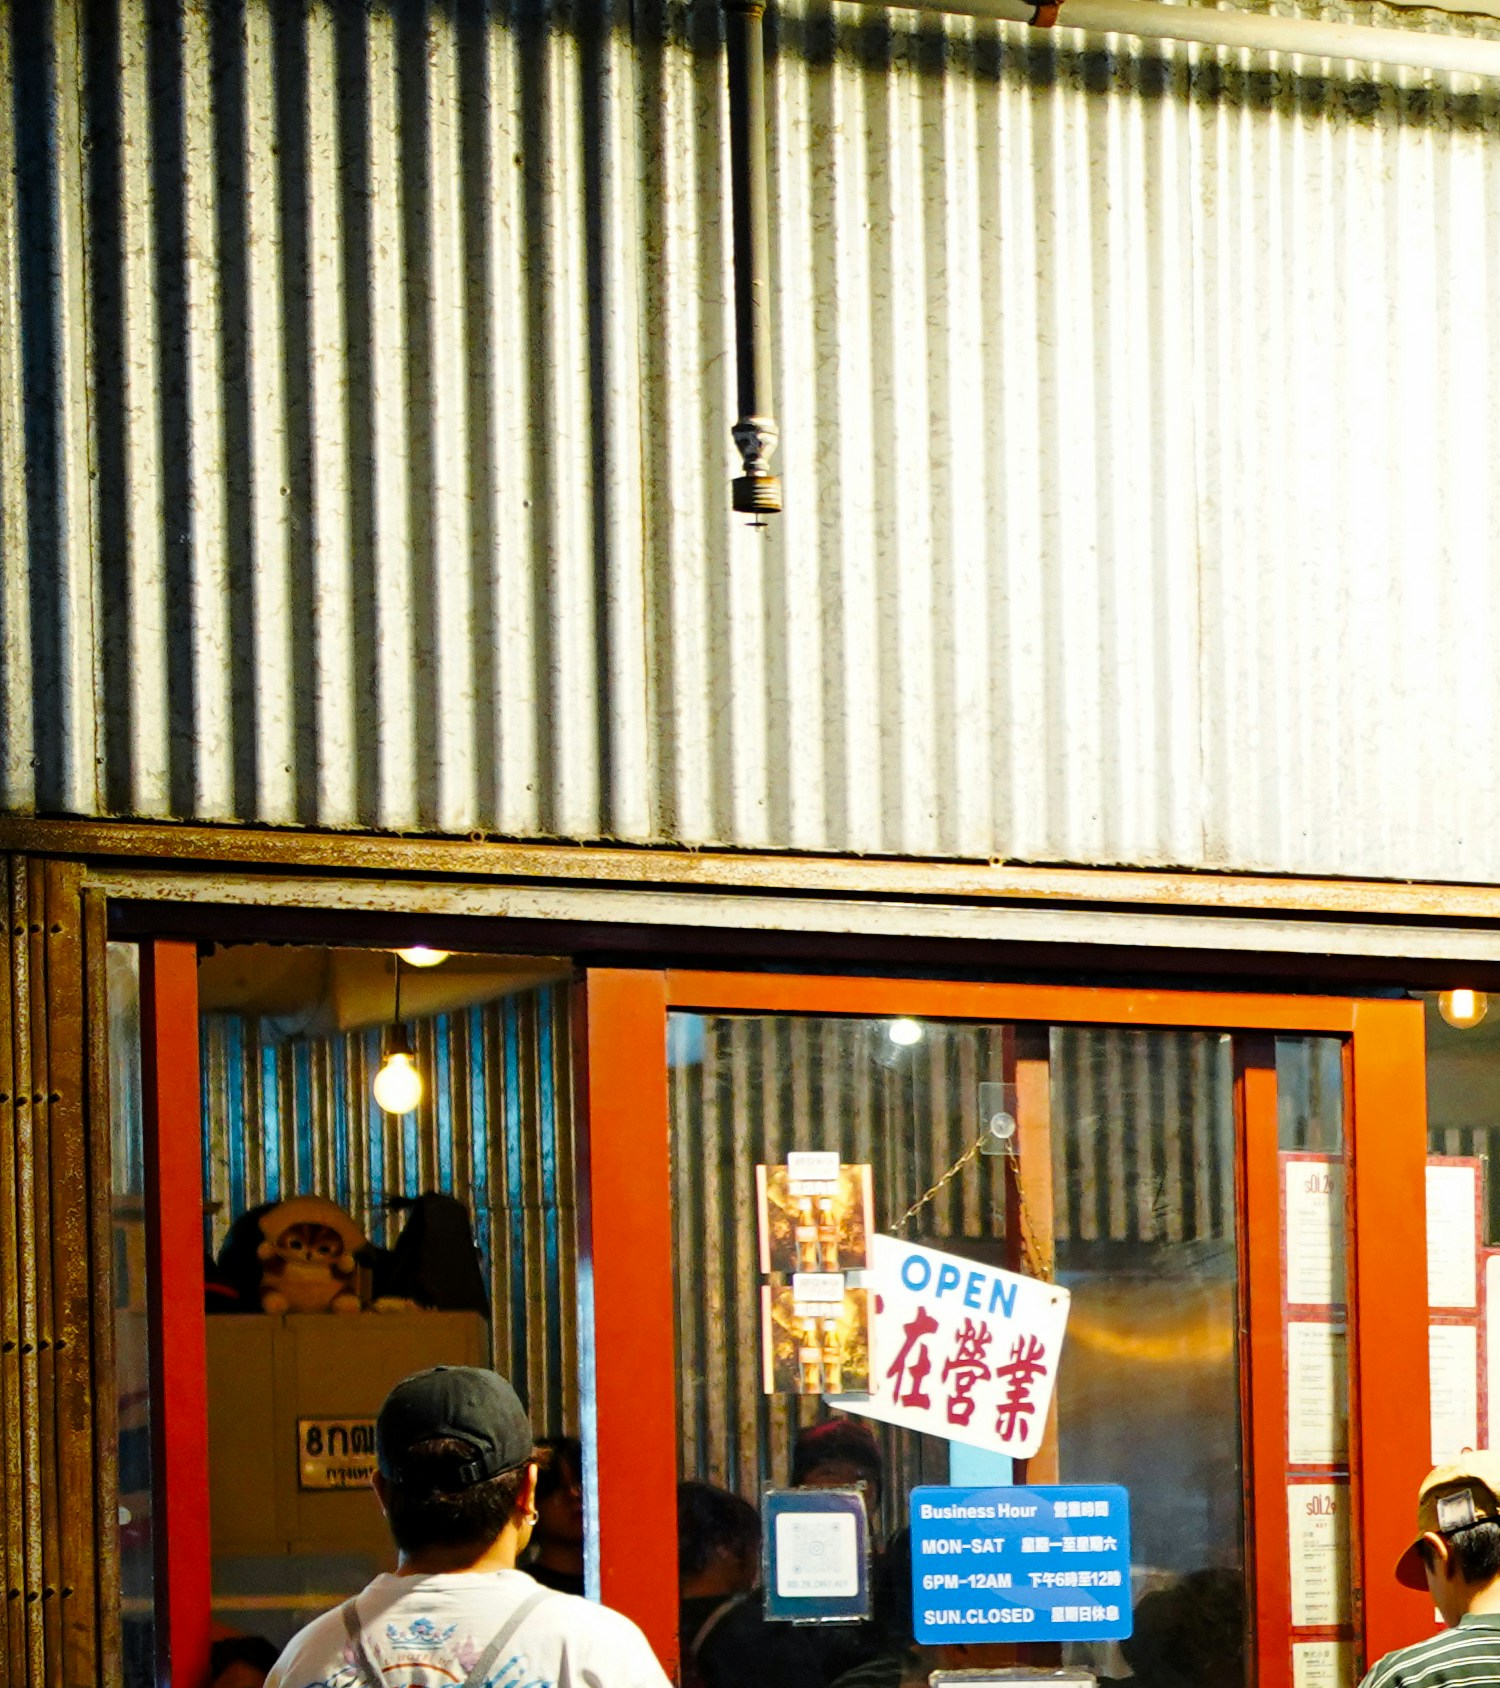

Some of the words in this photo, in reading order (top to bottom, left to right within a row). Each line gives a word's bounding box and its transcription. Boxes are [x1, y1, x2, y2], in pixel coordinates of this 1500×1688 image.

[900, 1254, 1018, 1319] OPEN
[873, 1295, 1048, 1442] 在營業
[919, 1503, 996, 1519] Business
[997, 1502, 1039, 1519] Hour
[1053, 1500, 1110, 1519] 營業時間
[921, 1537, 1006, 1555] MON-SAT
[1020, 1535, 1118, 1553] 星期一至星期六
[922, 1572, 1013, 1590] 6PM-12AM
[1027, 1570, 1122, 1588] 下午6時至12時
[924, 1608, 1036, 1626] SUN.CLOSED
[1050, 1604, 1121, 1623] 星期日休息
